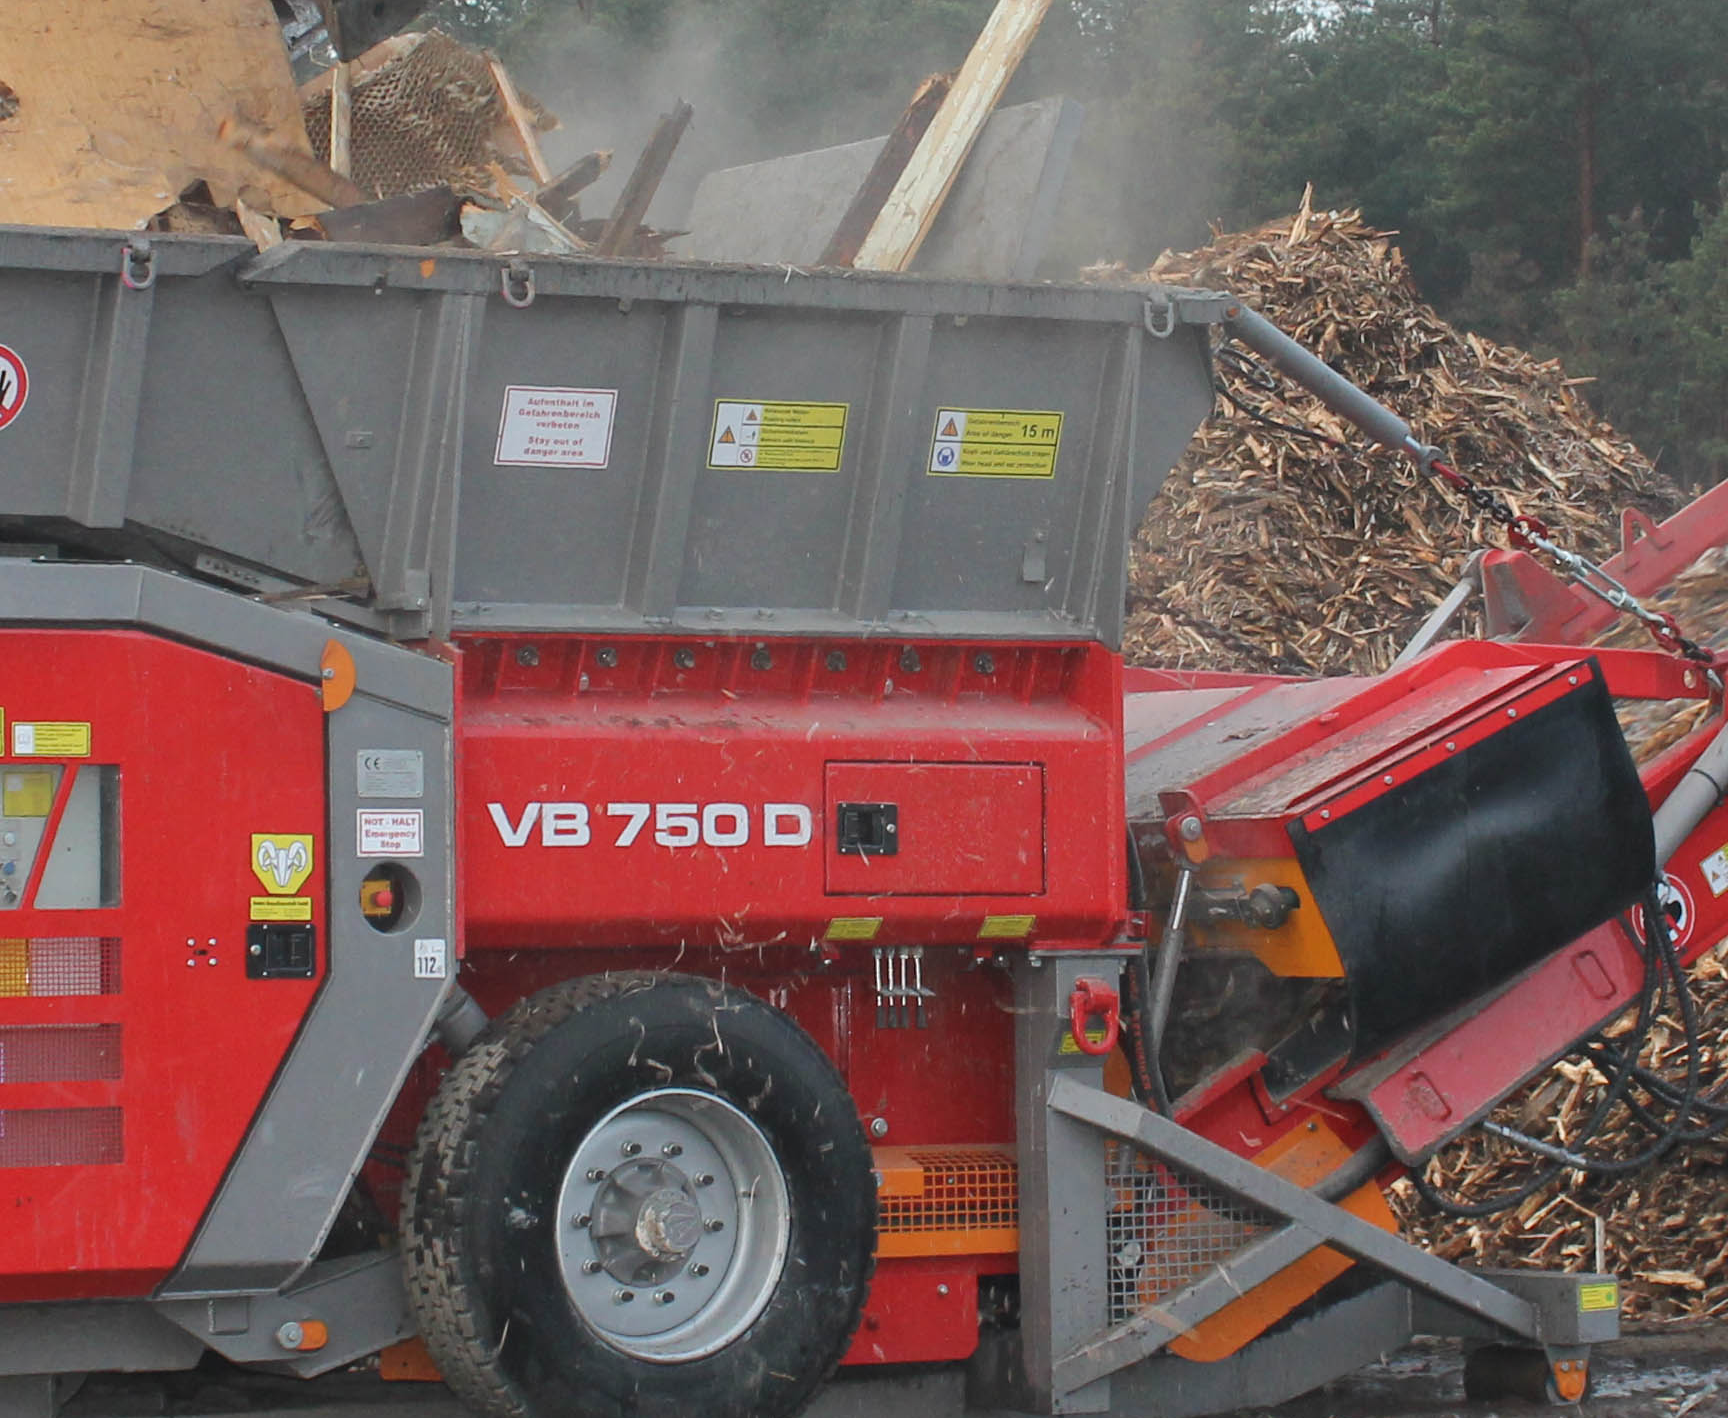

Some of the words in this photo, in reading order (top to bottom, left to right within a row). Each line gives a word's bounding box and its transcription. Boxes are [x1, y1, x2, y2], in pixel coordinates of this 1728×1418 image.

[527, 398, 580, 407] Aufenthalt
[518, 408, 601, 419] Gefahrenbereich
[1021, 424, 1038, 438] 15
[1041, 428, 1055, 439] m
[528, 436, 550, 446] Stay
[553, 438, 570, 446] out
[572, 438, 584, 446] of
[523, 447, 558, 457] danger
[560, 449, 584, 457] area
[486, 802, 591, 847] VB
[606, 802, 750, 847] 750
[763, 802, 813, 847] D
[364, 829, 417, 840] Emergency
[380, 840, 401, 849] Stop
[417, 956, 437, 974] 112
